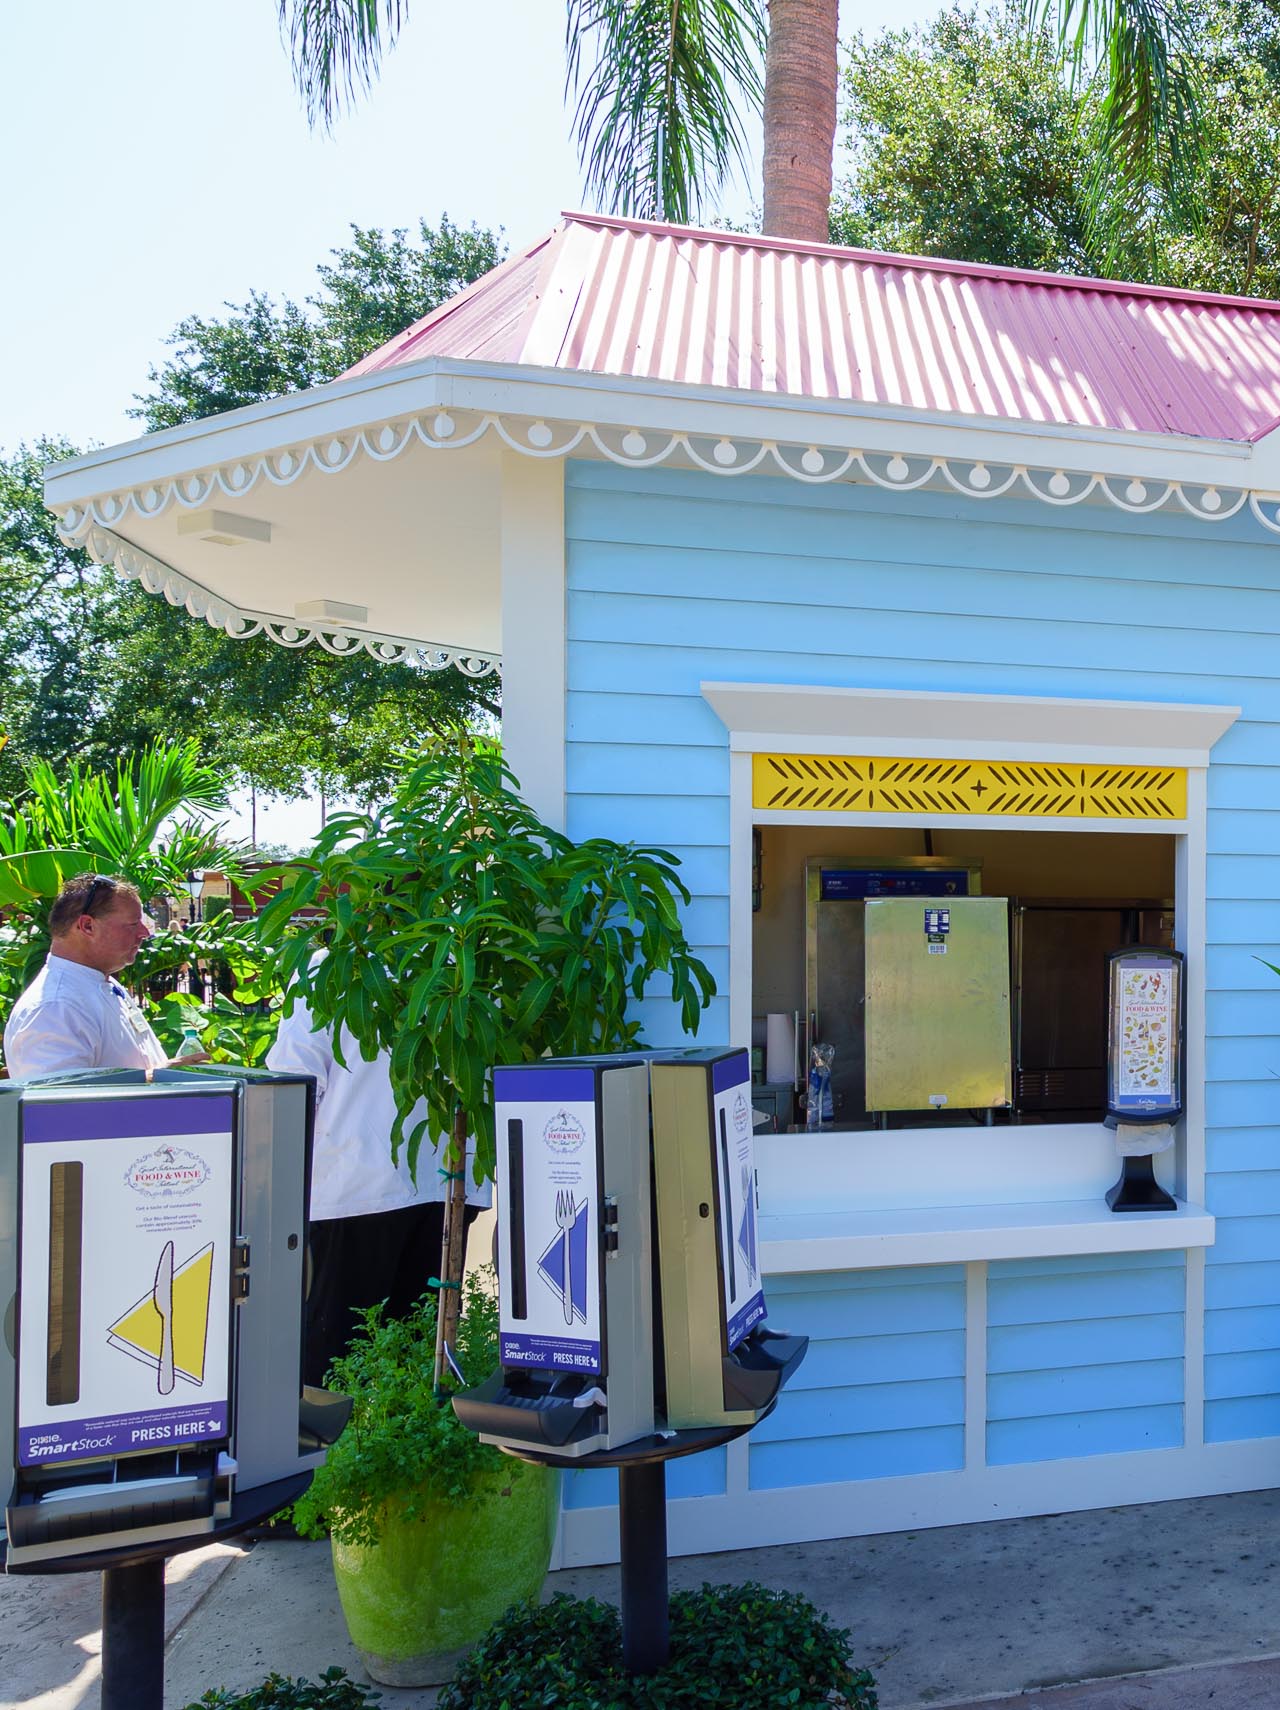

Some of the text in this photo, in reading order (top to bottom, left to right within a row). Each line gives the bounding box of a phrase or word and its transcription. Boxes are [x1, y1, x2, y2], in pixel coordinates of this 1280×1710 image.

[134, 1173, 164, 1182] FOOD
[174, 1170, 201, 1179] WINE
[504, 1349, 591, 1367] SmartStock PRESS HERE
[28, 1420, 206, 1458] SmartStock PRESS HERE
